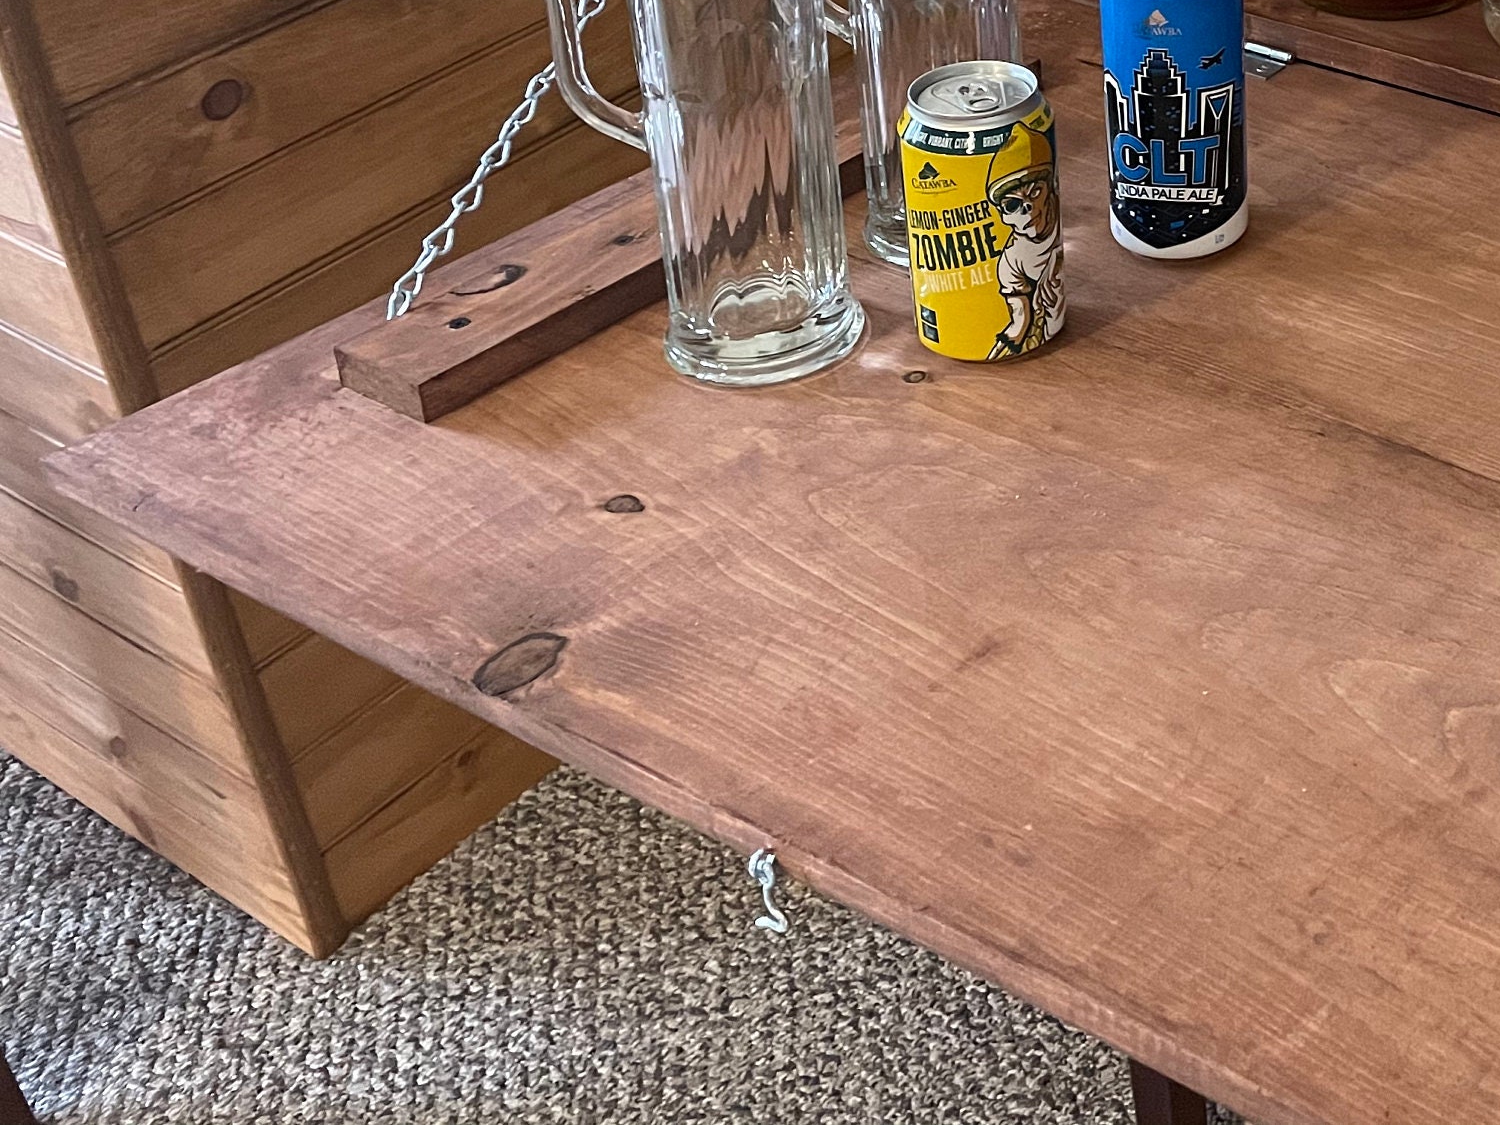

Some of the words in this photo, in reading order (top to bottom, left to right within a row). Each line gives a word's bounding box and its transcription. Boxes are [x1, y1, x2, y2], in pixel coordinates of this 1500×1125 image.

[1113, 132, 1221, 186] CLT
[911, 177, 958, 190] CATAWBA
[1151, 188, 1186, 201] PALE
[1187, 188, 1215, 201] ALE
[909, 200, 993, 231] LEMON-GINGER
[911, 221, 1001, 272] ZOMBIE
[926, 271, 967, 294] WHITE
[970, 264, 994, 286] ALE
